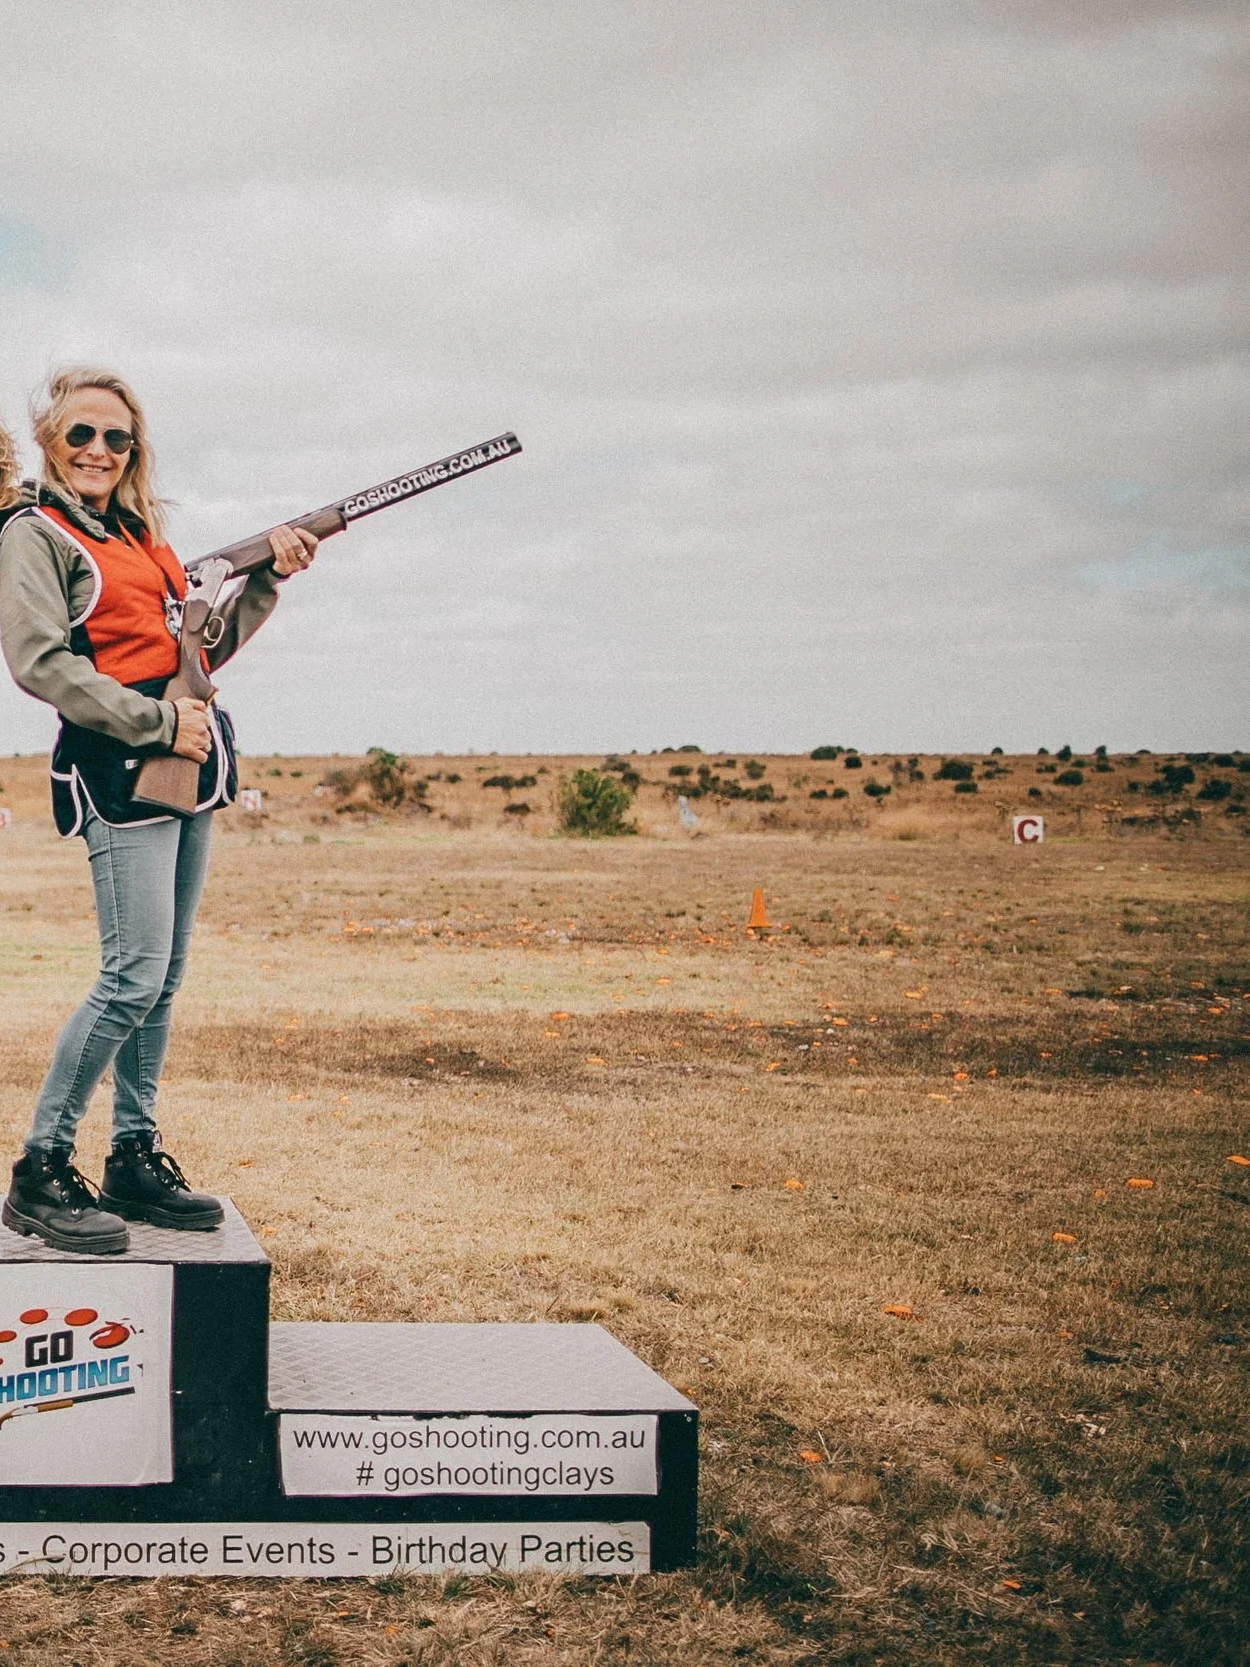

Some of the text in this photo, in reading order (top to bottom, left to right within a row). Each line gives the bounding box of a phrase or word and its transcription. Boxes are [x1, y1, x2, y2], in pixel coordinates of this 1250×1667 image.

[344, 438, 511, 516] GOSHOOTING.COM.AU
[1017, 818, 1039, 844] C
[25, 1329, 74, 1368] GO
[294, 1425, 645, 1455] www.goshooting.com.au
[42, 1534, 209, 1570] Corporate
[223, 1534, 336, 1564] Events
[372, 1535, 508, 1568] Birthday
[520, 1533, 635, 1563] Parties
